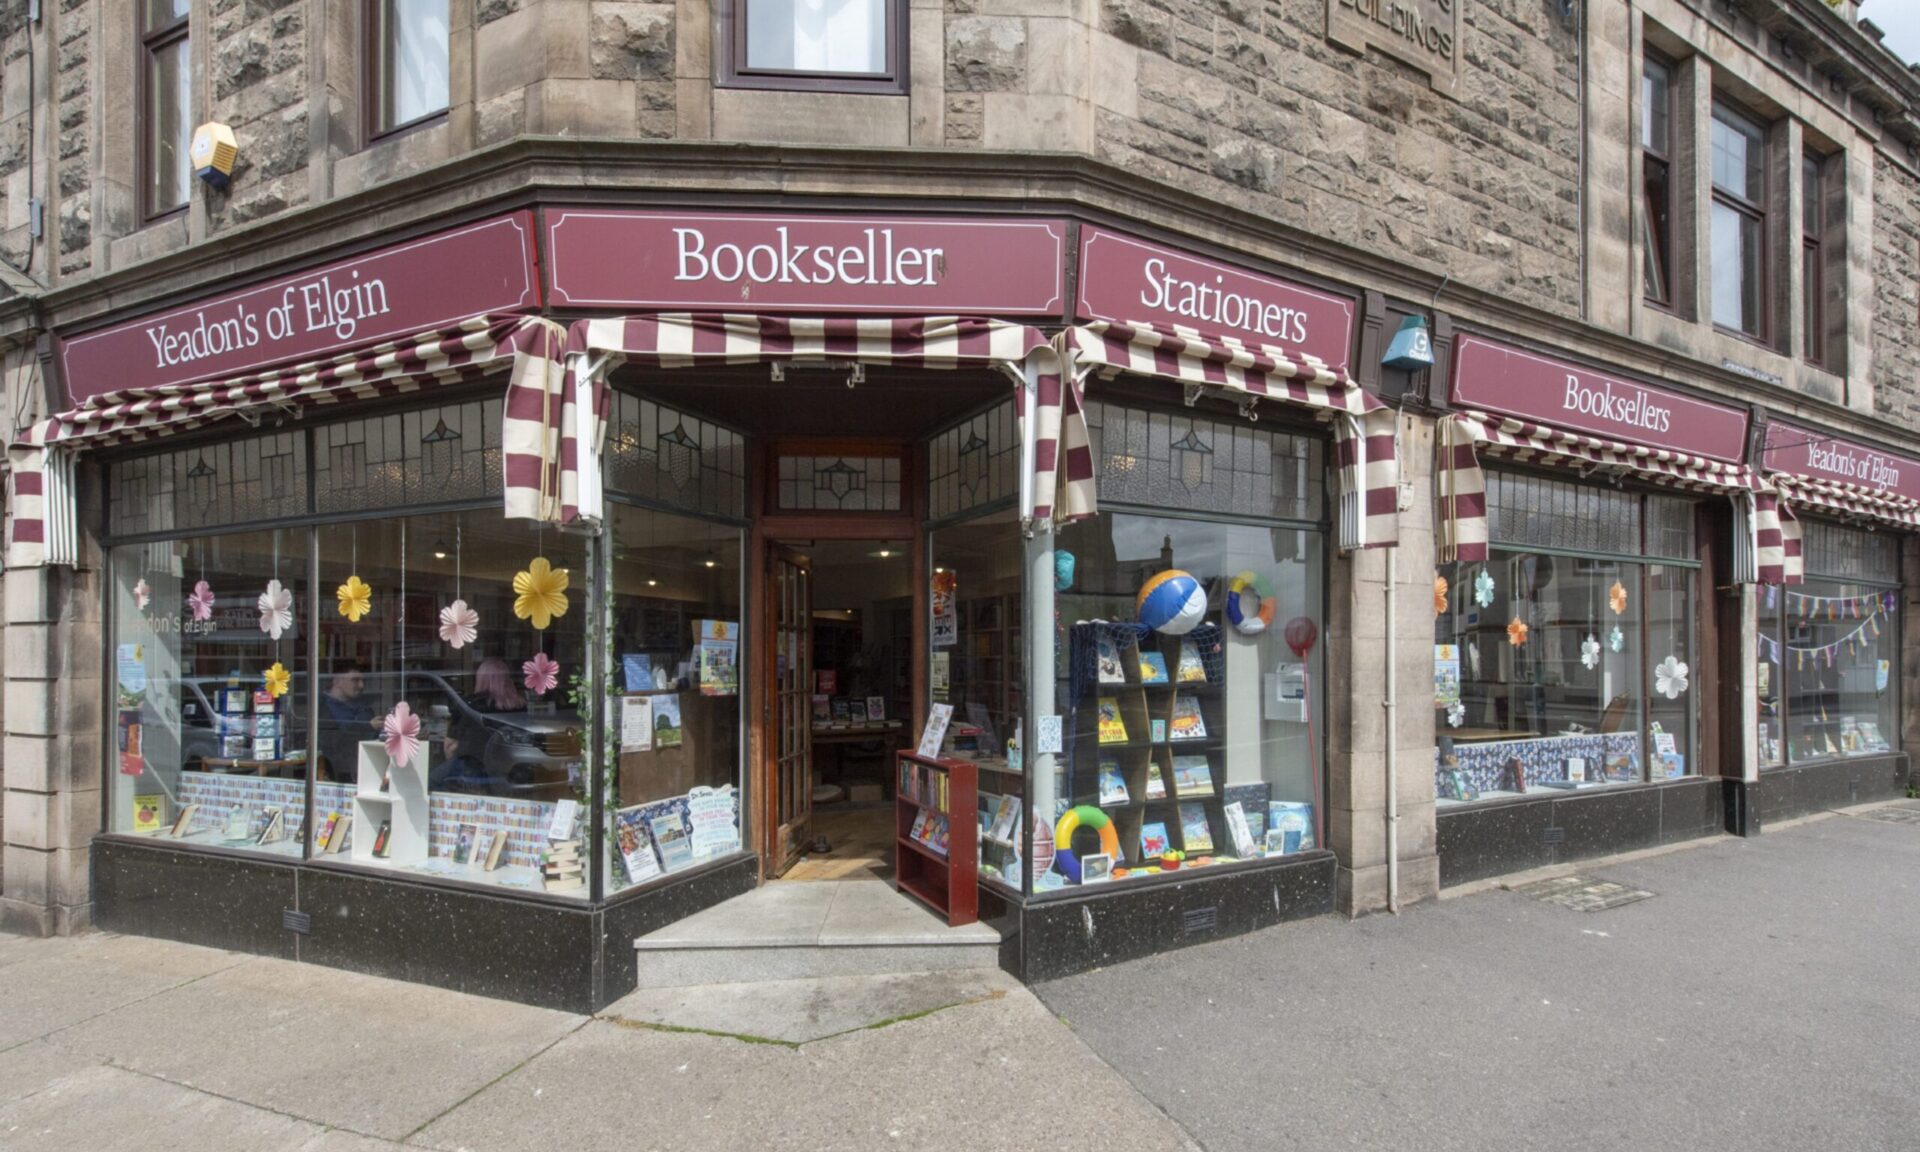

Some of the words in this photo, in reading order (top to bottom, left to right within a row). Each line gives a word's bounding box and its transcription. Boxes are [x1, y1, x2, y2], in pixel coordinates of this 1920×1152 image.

[672, 226, 944, 286] Bookseller
[146, 303, 260, 369] Yeadon's
[266, 288, 299, 342] of
[300, 269, 391, 341] Elgin
[1140, 257, 1308, 345] Stationers
[1562, 374, 1672, 434] Booksellers
[1806, 440, 1855, 479] Yeadon's
[1857, 453, 1872, 480] of
[1871, 455, 1899, 491] Elgin
[184, 619, 193, 633] of
[193, 619, 217, 635] Elgin
